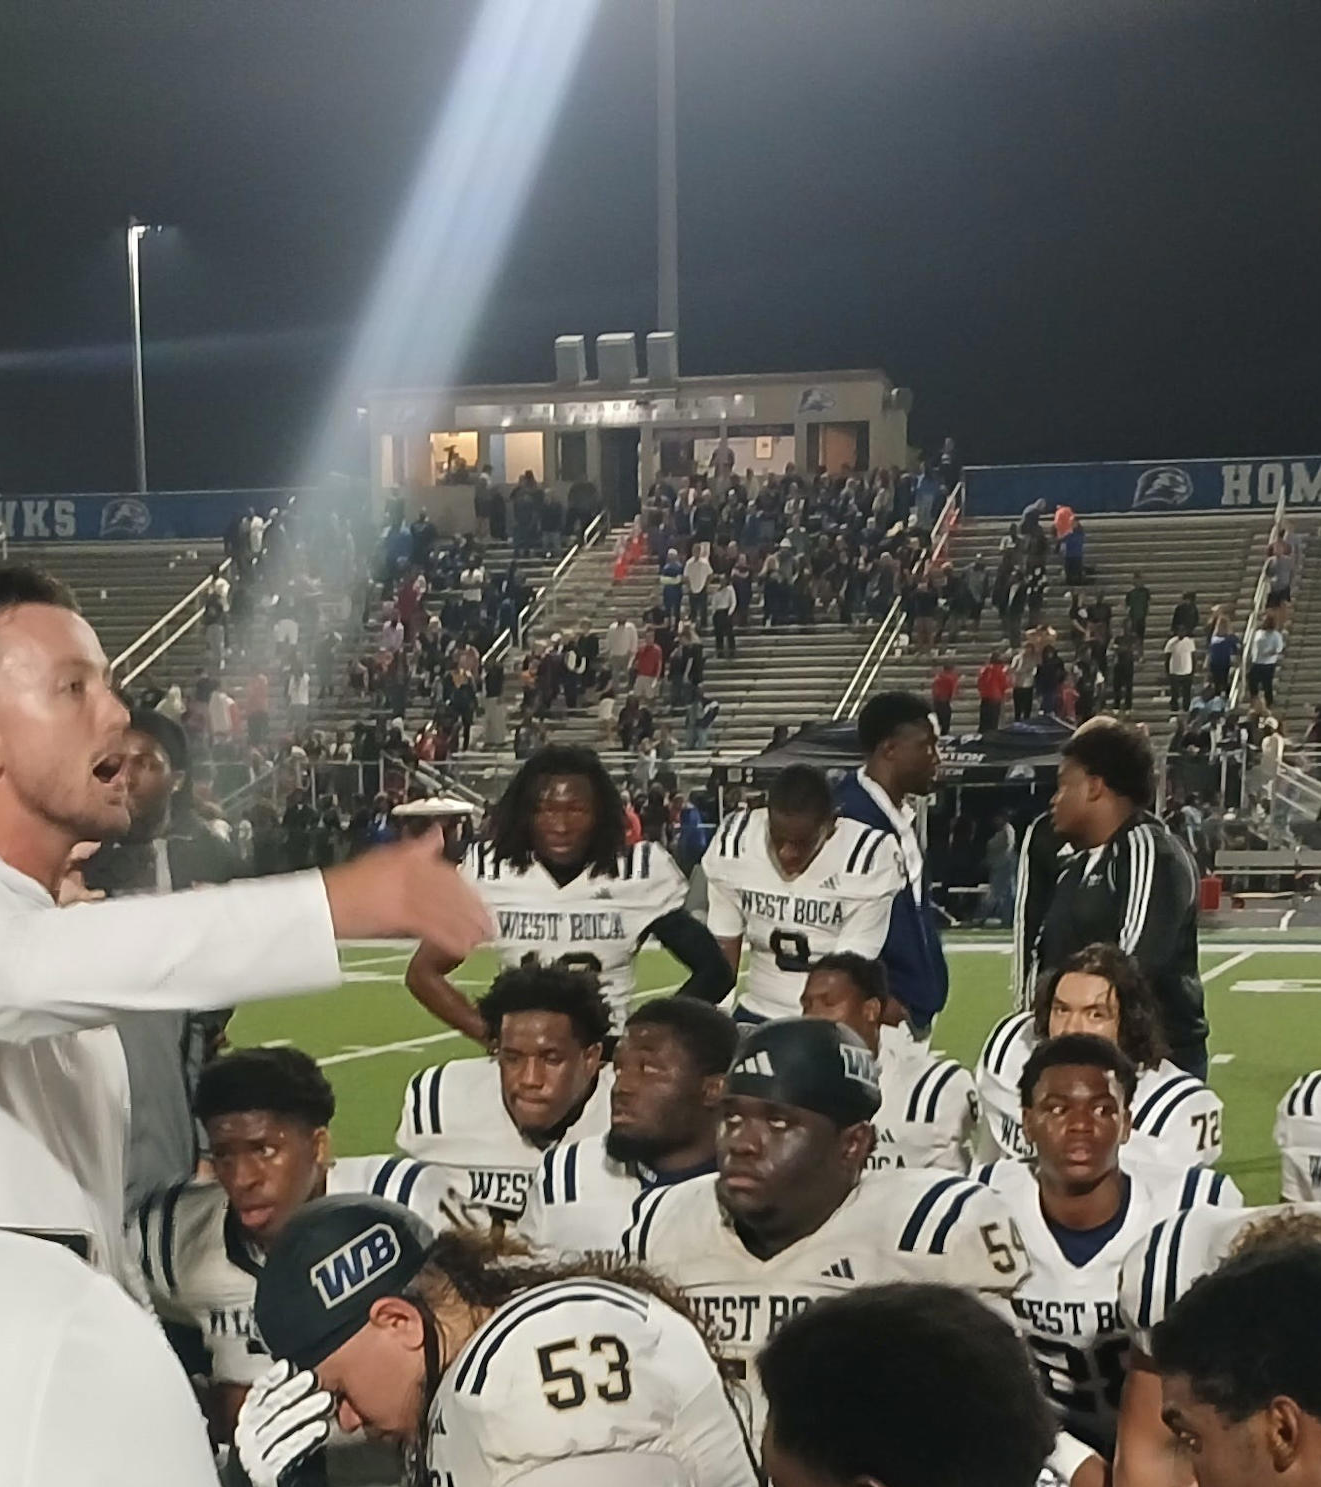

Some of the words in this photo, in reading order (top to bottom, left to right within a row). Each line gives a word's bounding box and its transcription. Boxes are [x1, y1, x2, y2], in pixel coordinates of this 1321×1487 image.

[497, 911, 563, 941] WEST
[569, 912, 626, 941] BOCA
[740, 888, 790, 921] WEST
[793, 896, 844, 926] BOCA
[1191, 1111, 1221, 1151] 72
[314, 1227, 400, 1304] WB
[537, 1334, 632, 1411] 53
